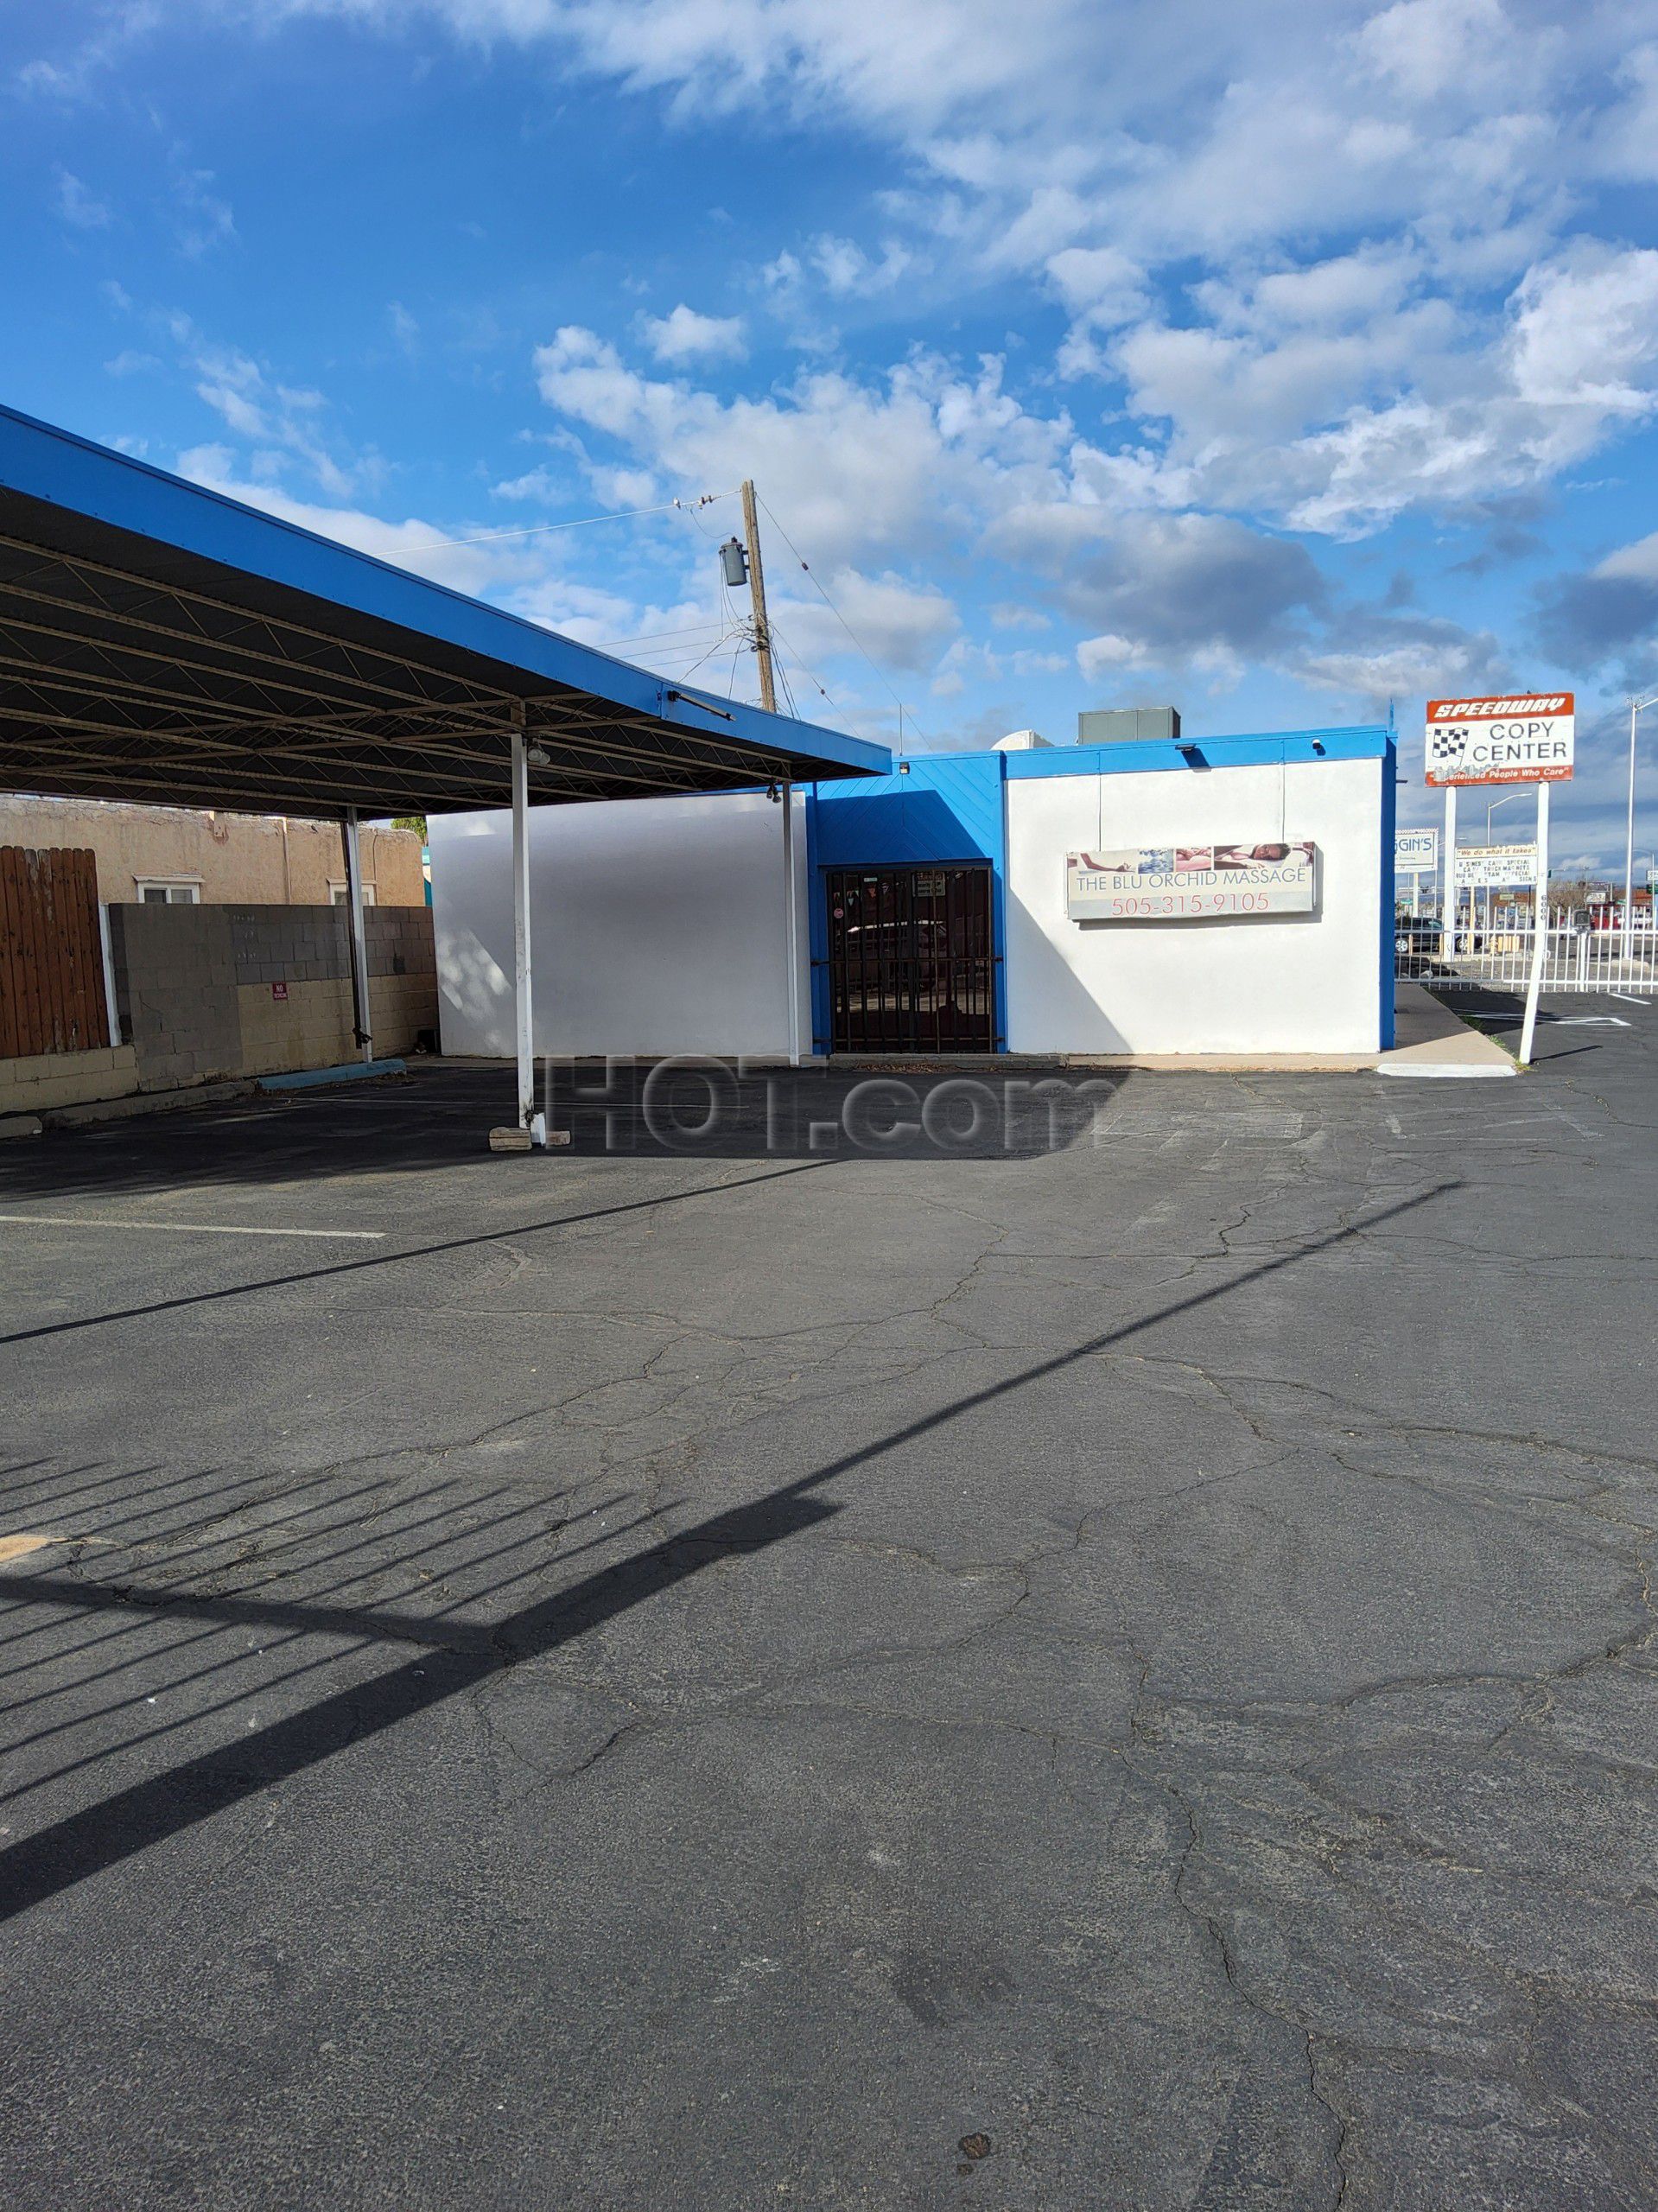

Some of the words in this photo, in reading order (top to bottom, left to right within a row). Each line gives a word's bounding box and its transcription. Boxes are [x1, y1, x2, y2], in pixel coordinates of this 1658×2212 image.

[1434, 697, 1566, 718] SPEEDWAY
[1490, 721, 1554, 741] COPY
[1472, 741, 1566, 762] CENTER
[1489, 770, 1518, 779] People
[1521, 768, 1542, 777] Who
[1396, 838, 1432, 852] GIN'S
[1077, 876, 1107, 891] THE
[1113, 874, 1142, 890] BLU
[1148, 871, 1217, 888] ORCHID
[1223, 868, 1305, 885] MASSAGE
[1112, 893, 1268, 916] 505-315-9105
